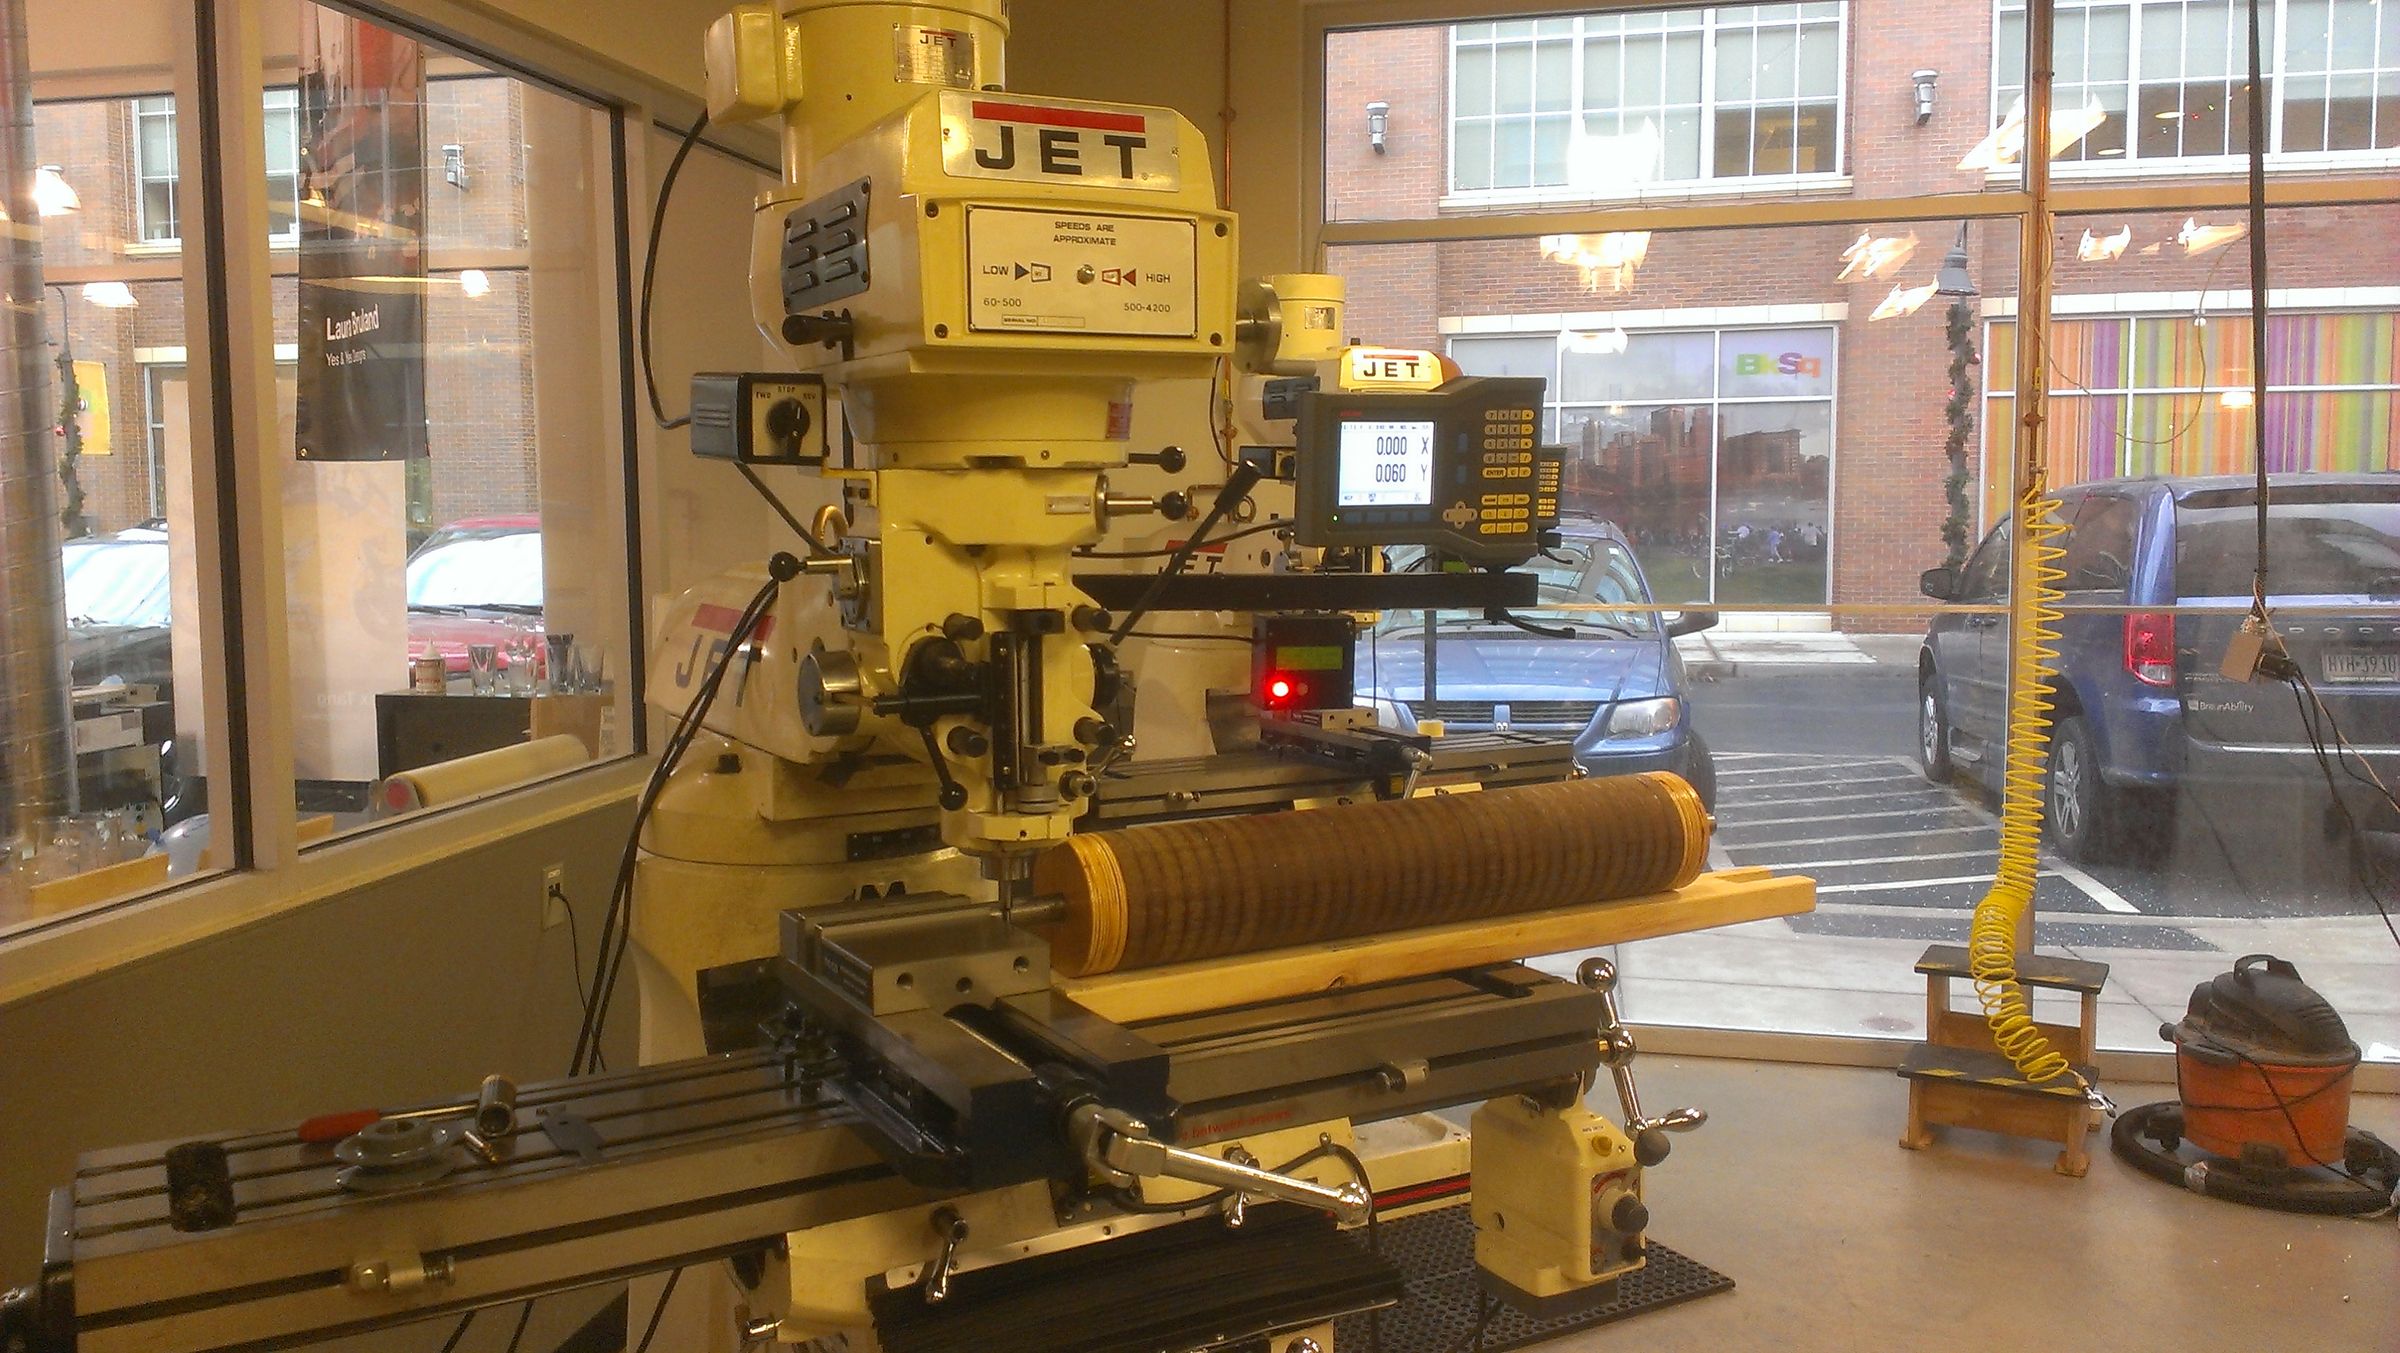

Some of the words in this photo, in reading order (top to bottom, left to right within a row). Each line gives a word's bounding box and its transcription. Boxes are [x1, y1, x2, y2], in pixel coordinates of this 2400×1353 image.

[919, 34, 957, 47] JET
[975, 125, 1146, 179] JET
[1055, 221, 1091, 231] SPEEDS
[1096, 224, 1115, 232] ARE
[1053, 235, 1117, 246] APPROXIMATE
[983, 264, 1009, 276] LOW
[1145, 273, 1171, 284] HIGH
[983, 298, 1022, 307] 60-500
[1123, 303, 1171, 313] 500-4200
[326, 353, 339, 367] Yes
[1736, 352, 1821, 378] BkSq
[1363, 361, 1420, 378] JET
[777, 385, 796, 393] STOP
[1376, 436, 1407, 456] 0.000
[1421, 437, 1429, 455] X
[1375, 464, 1406, 483] 0.060
[1420, 464, 1428, 482] Y
